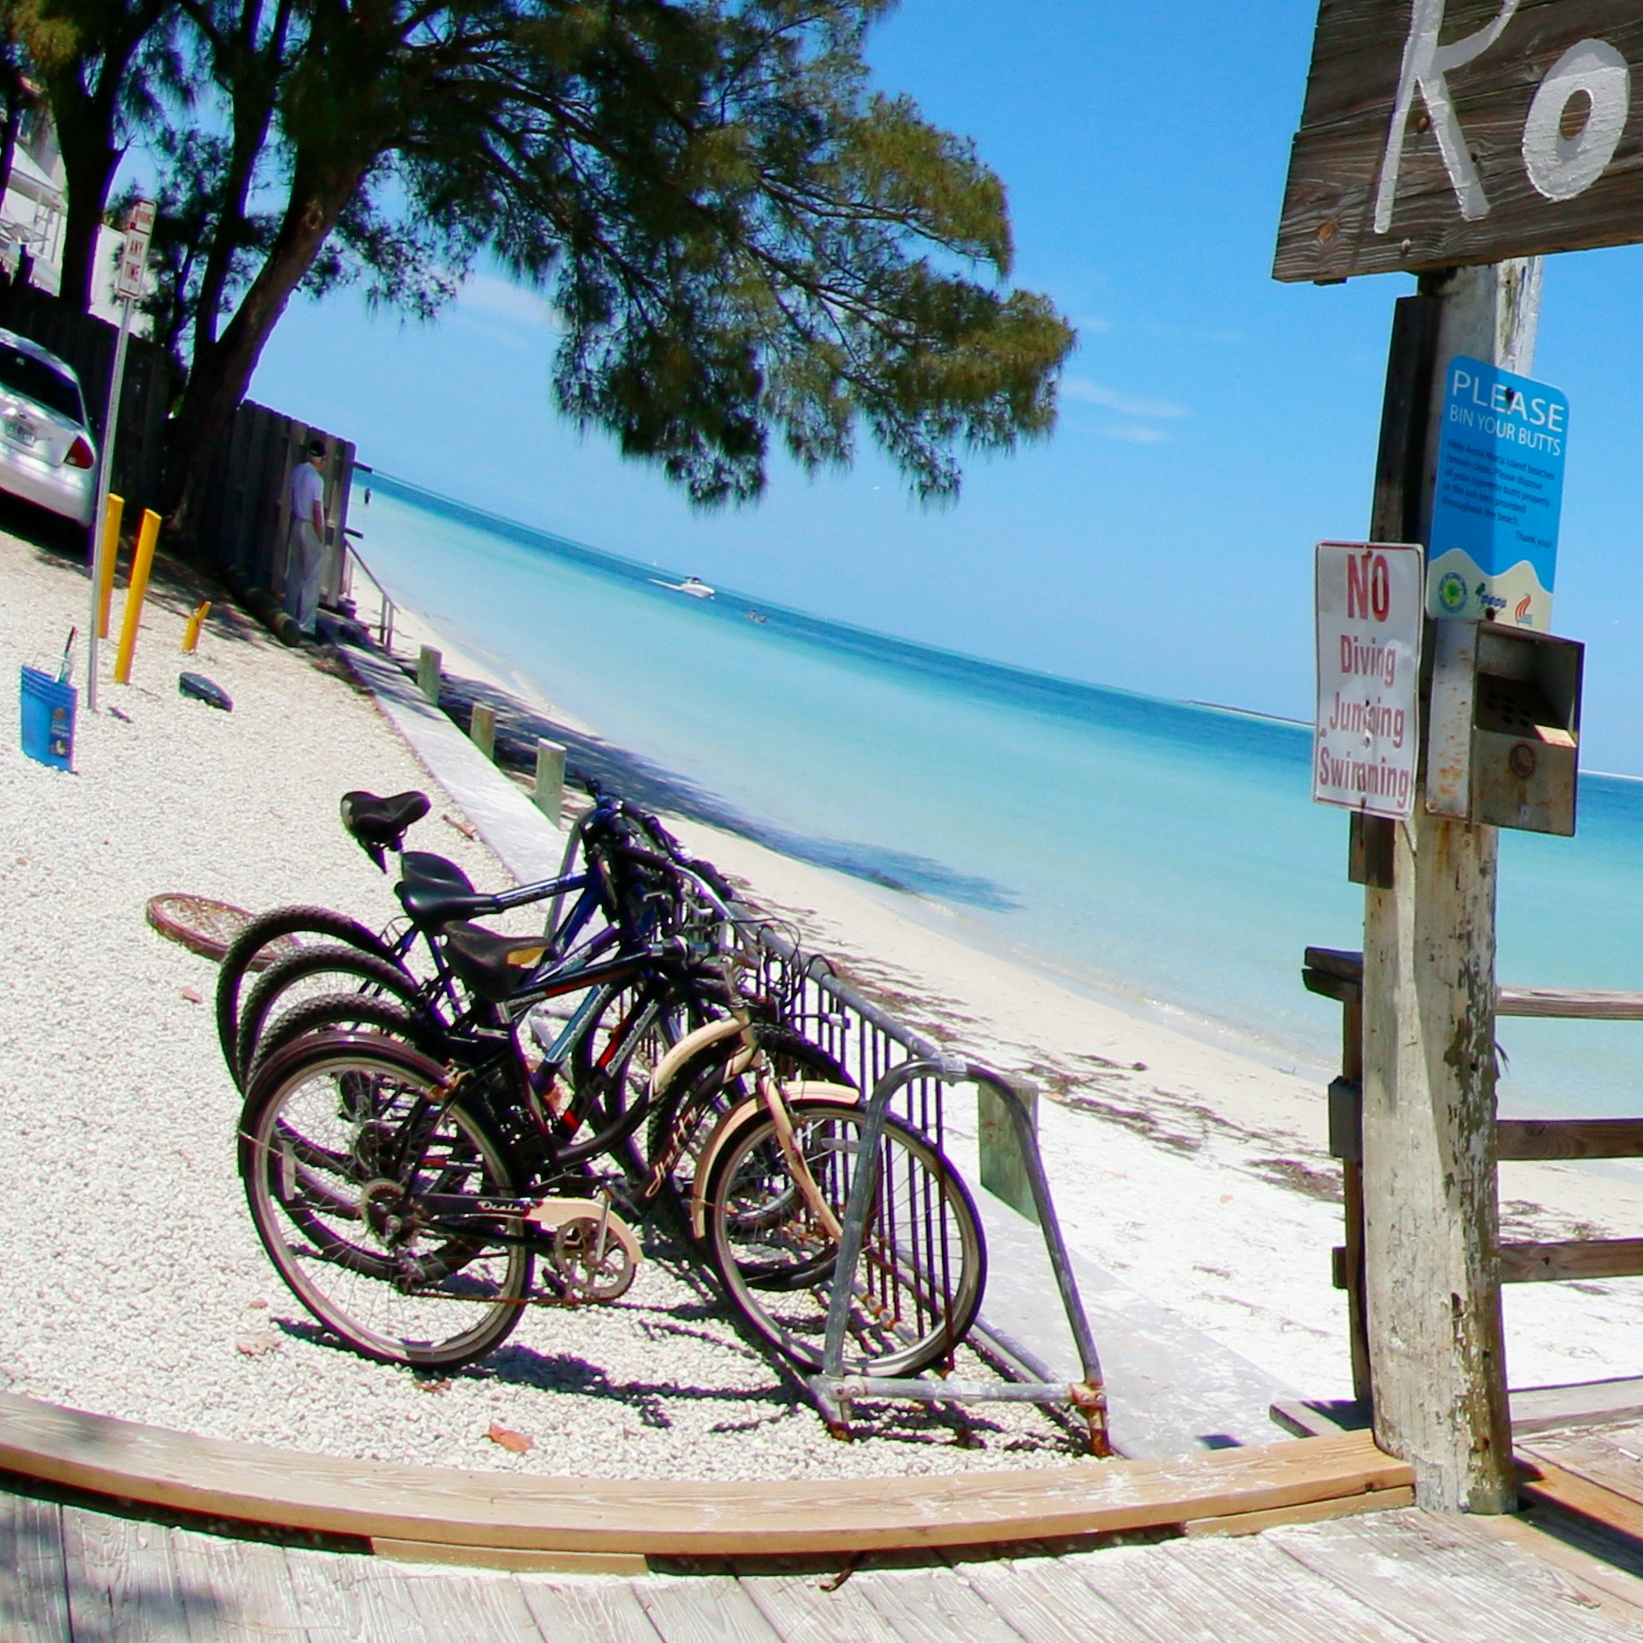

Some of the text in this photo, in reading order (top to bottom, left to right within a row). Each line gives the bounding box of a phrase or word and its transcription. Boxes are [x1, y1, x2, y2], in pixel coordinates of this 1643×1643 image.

[1449, 404, 1561, 457] BIN YOUR BUTTS
[1452, 369, 1565, 433] PLEASE
[1346, 552, 1390, 623] NO
[1340, 634, 1396, 687] Diving
[1320, 746, 1410, 809] Swimming
